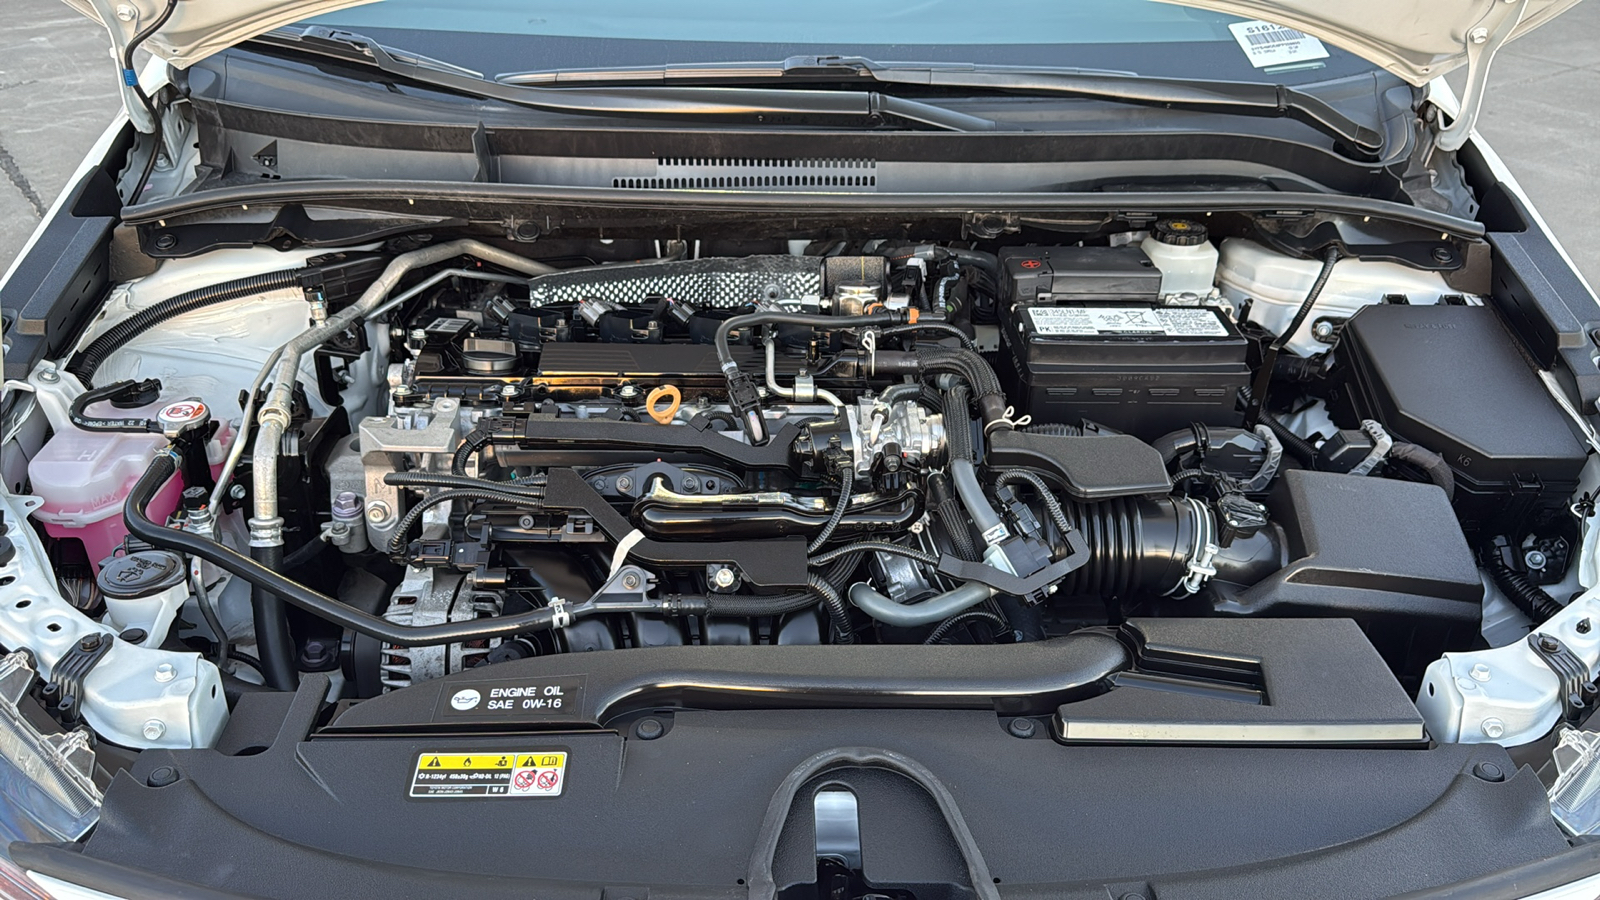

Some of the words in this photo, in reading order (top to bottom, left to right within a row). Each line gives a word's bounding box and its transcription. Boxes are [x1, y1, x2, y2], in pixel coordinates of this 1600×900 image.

[92, 491, 117, 507] MAX
[489, 686, 537, 698] ENGINE
[543, 685, 564, 696] OIL
[487, 699, 514, 709] SAE
[522, 698, 562, 709] 0W-16
